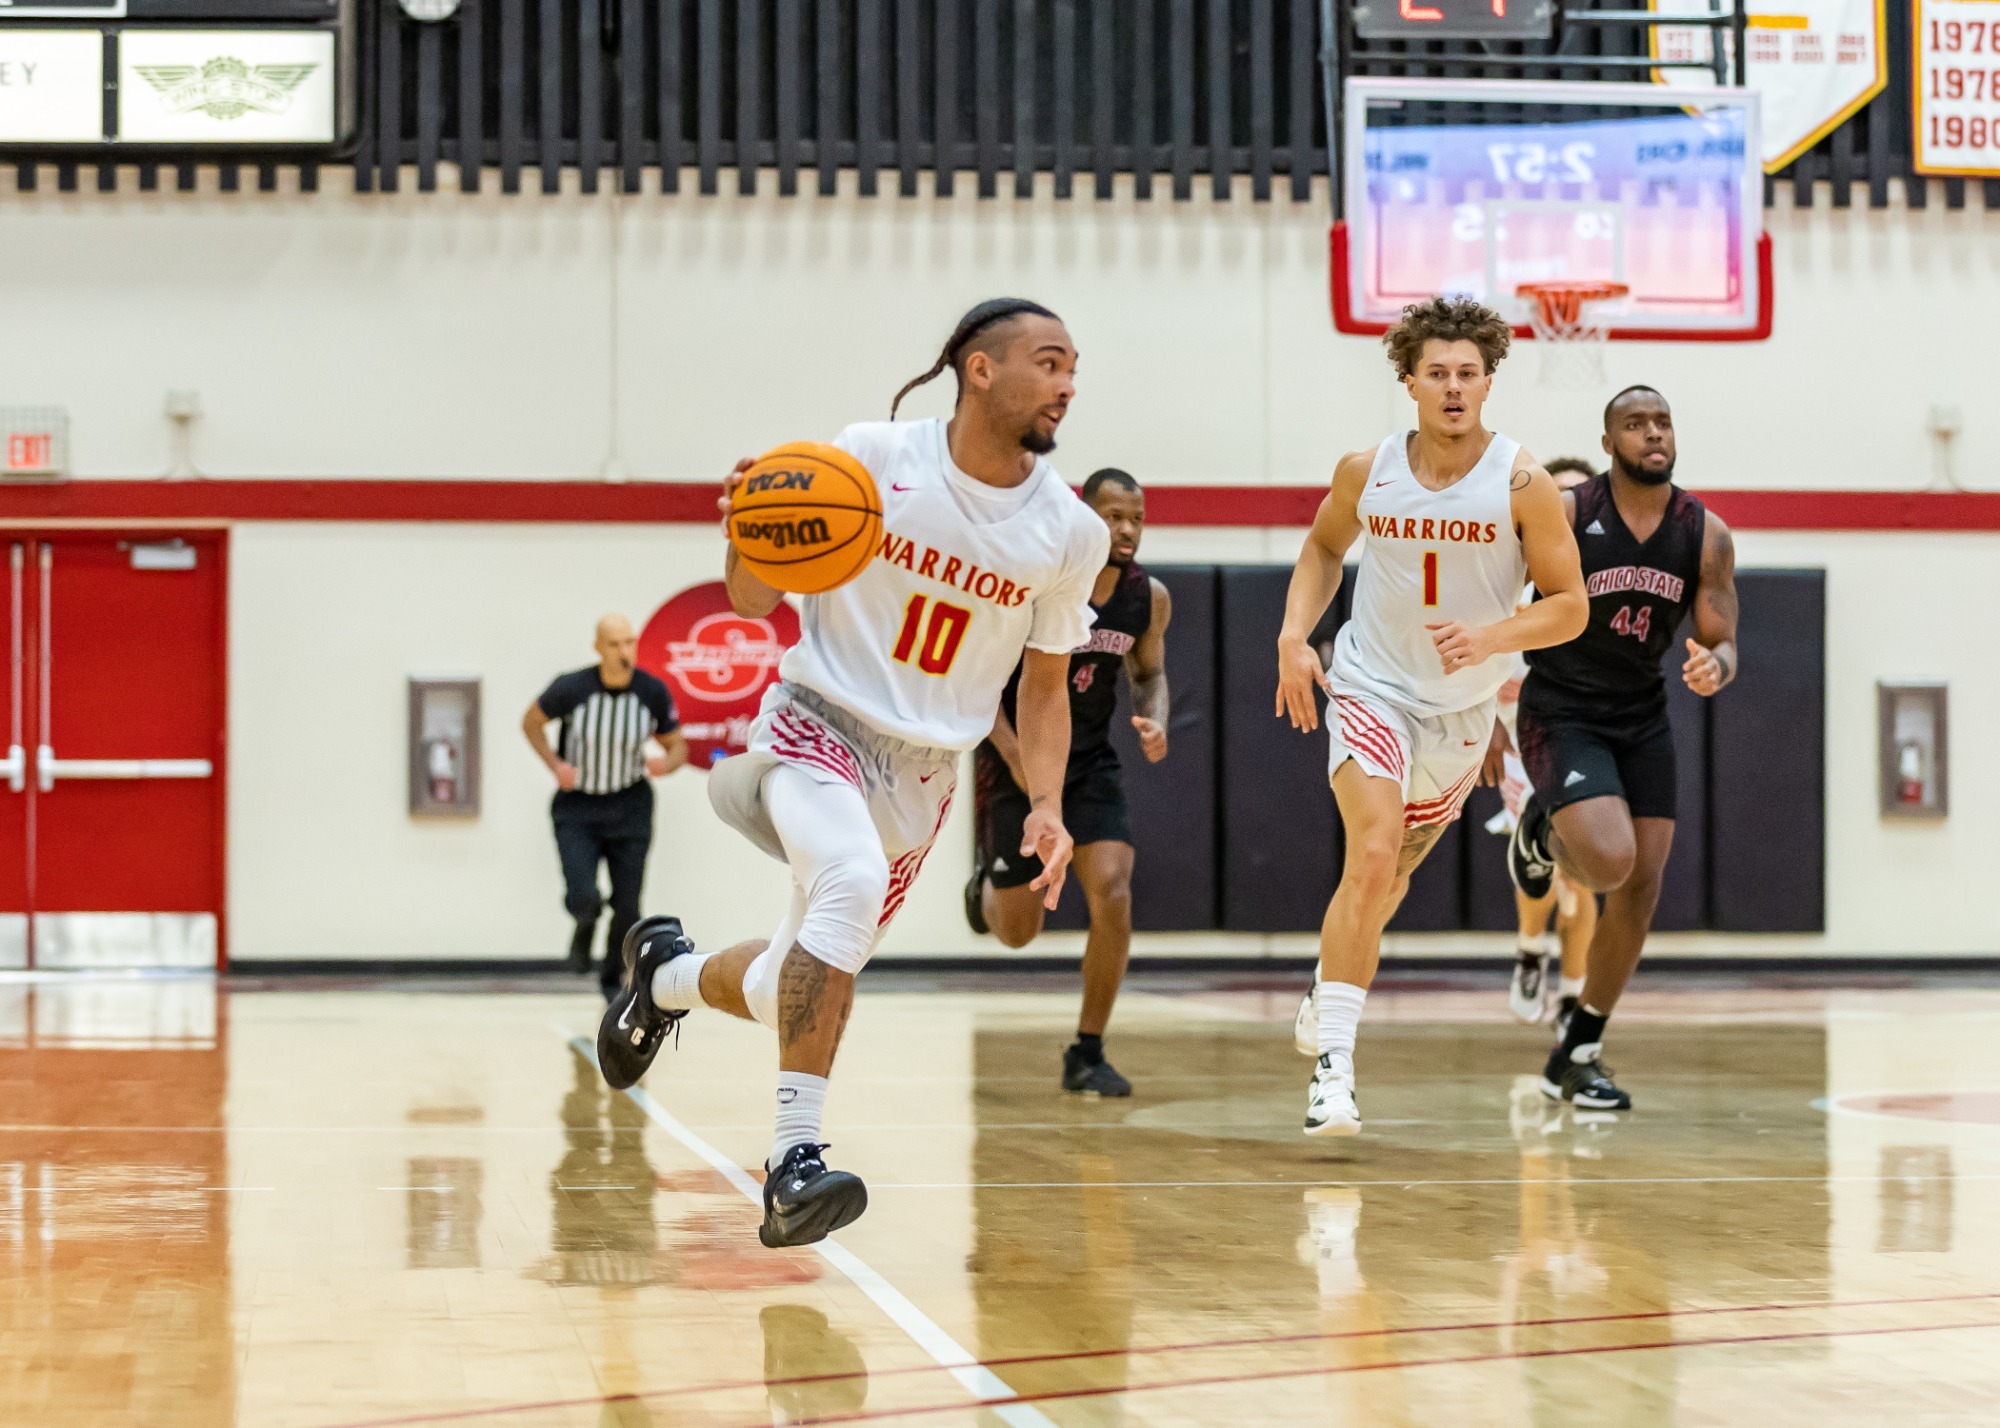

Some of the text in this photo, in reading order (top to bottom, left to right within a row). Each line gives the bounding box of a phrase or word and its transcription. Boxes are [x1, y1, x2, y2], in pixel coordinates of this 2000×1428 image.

[746, 470, 816, 496] NCAA
[736, 516, 832, 549] Wilson
[1368, 515, 1497, 544] WARRIORS
[1422, 551, 1439, 607] 1
[891, 592, 972, 678] 10
[1610, 605, 1652, 642] 44
[1072, 663, 1098, 693] 4
